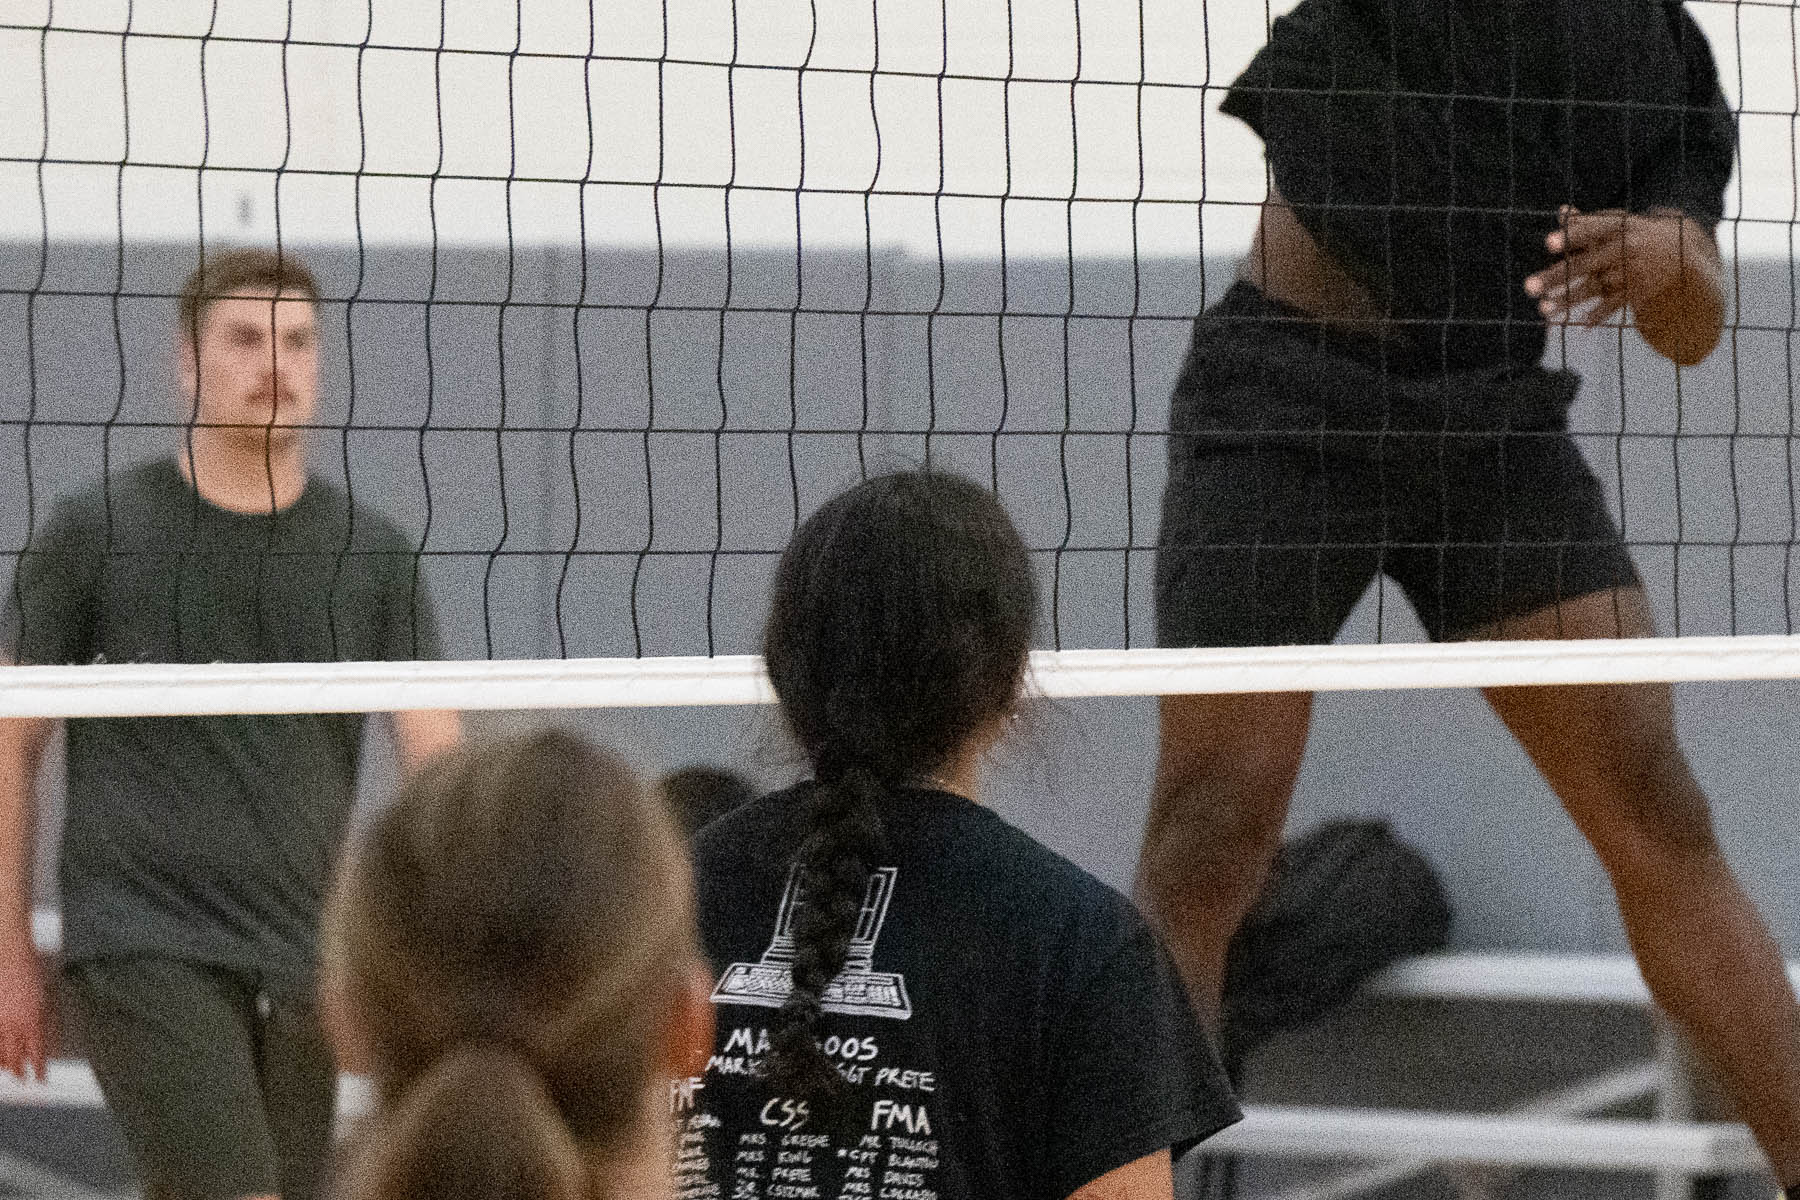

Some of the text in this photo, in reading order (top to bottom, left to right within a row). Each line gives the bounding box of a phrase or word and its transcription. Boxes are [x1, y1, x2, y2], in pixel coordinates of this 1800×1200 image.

[874, 1067, 936, 1092] PRETE
[760, 1097, 810, 1131] CSS
[870, 1100, 932, 1135] FMA
